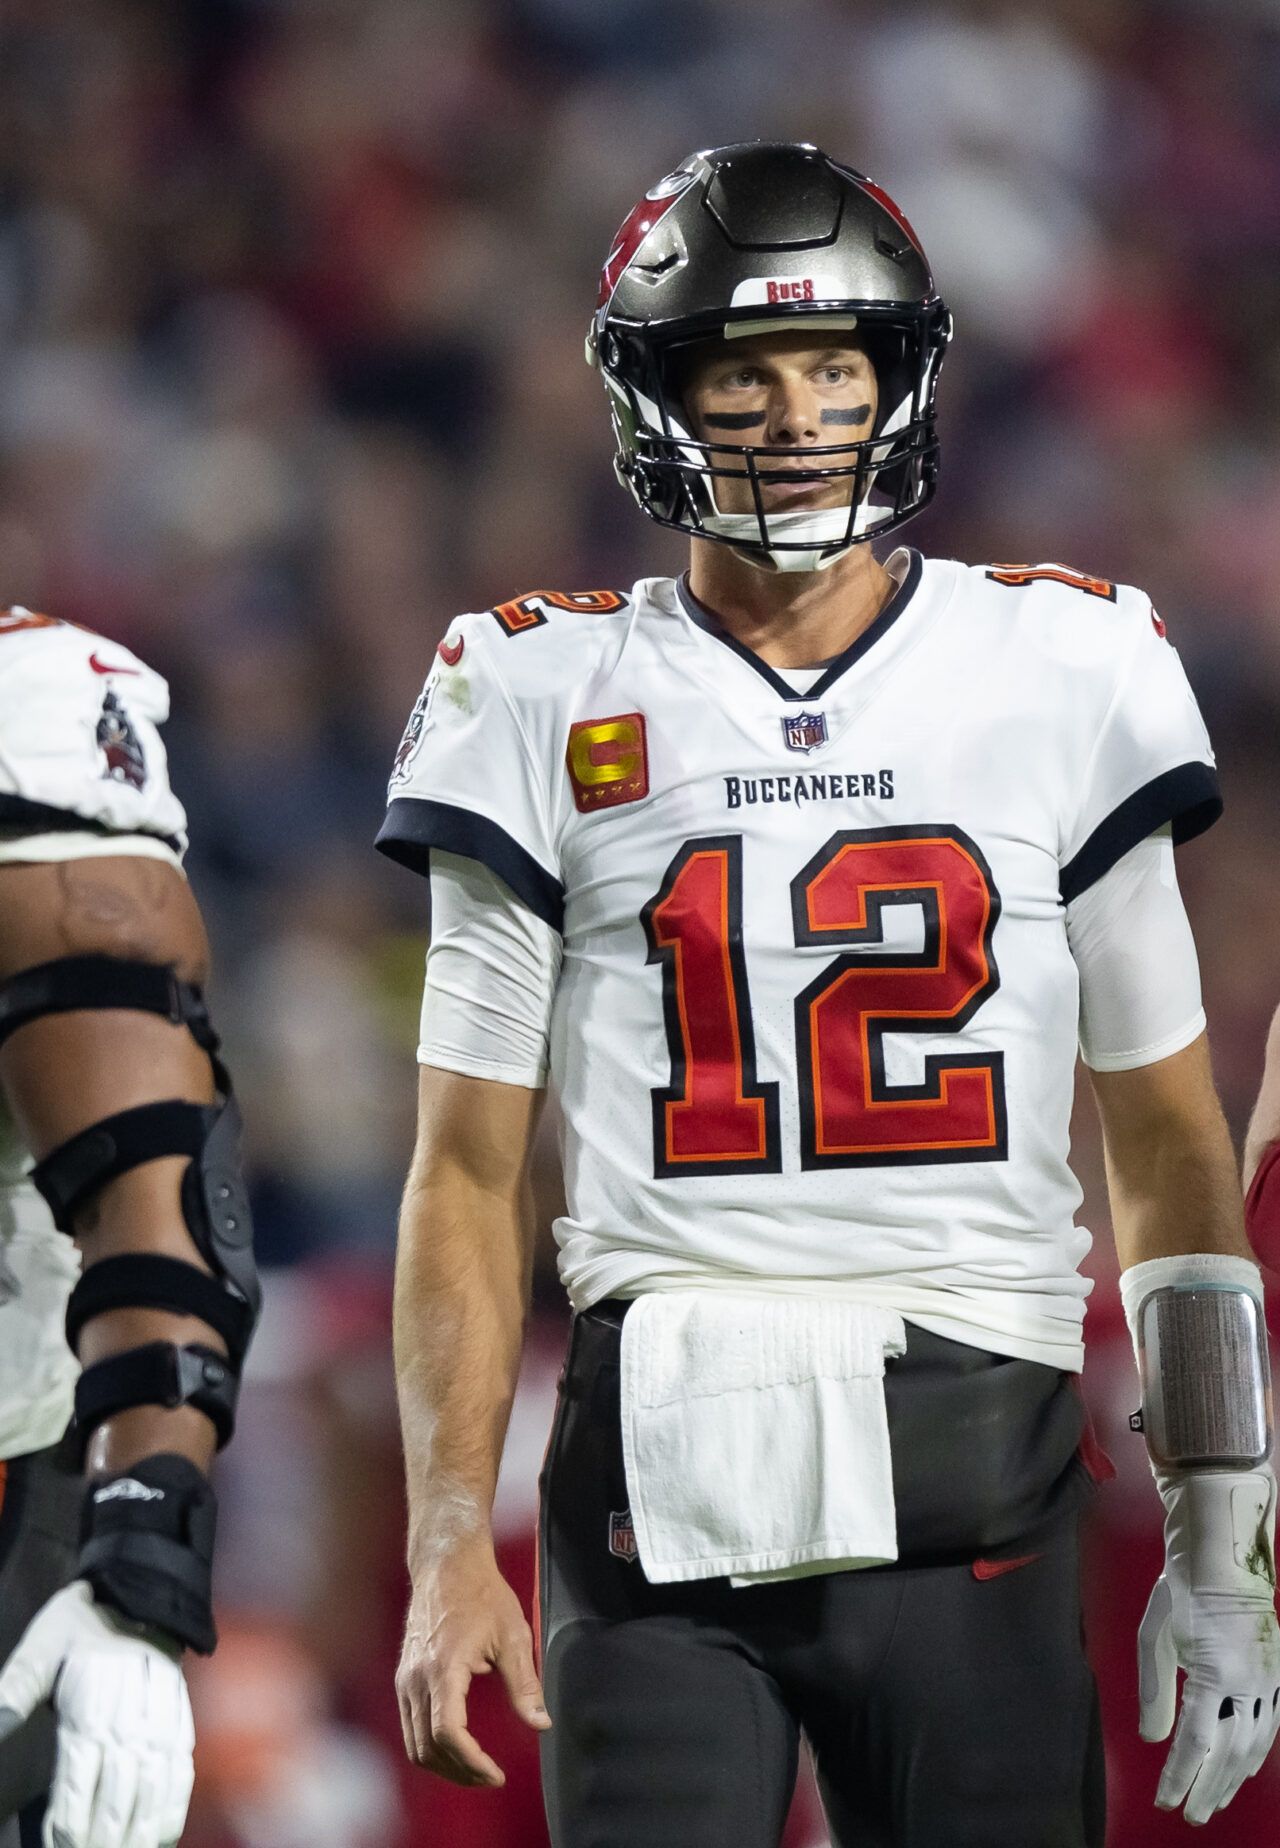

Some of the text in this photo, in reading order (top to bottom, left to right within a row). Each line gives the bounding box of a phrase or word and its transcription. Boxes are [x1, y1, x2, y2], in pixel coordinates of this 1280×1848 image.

[569, 721, 640, 786] C
[723, 769, 894, 809] BUCCANEERS
[639, 823, 1009, 1179] 12
